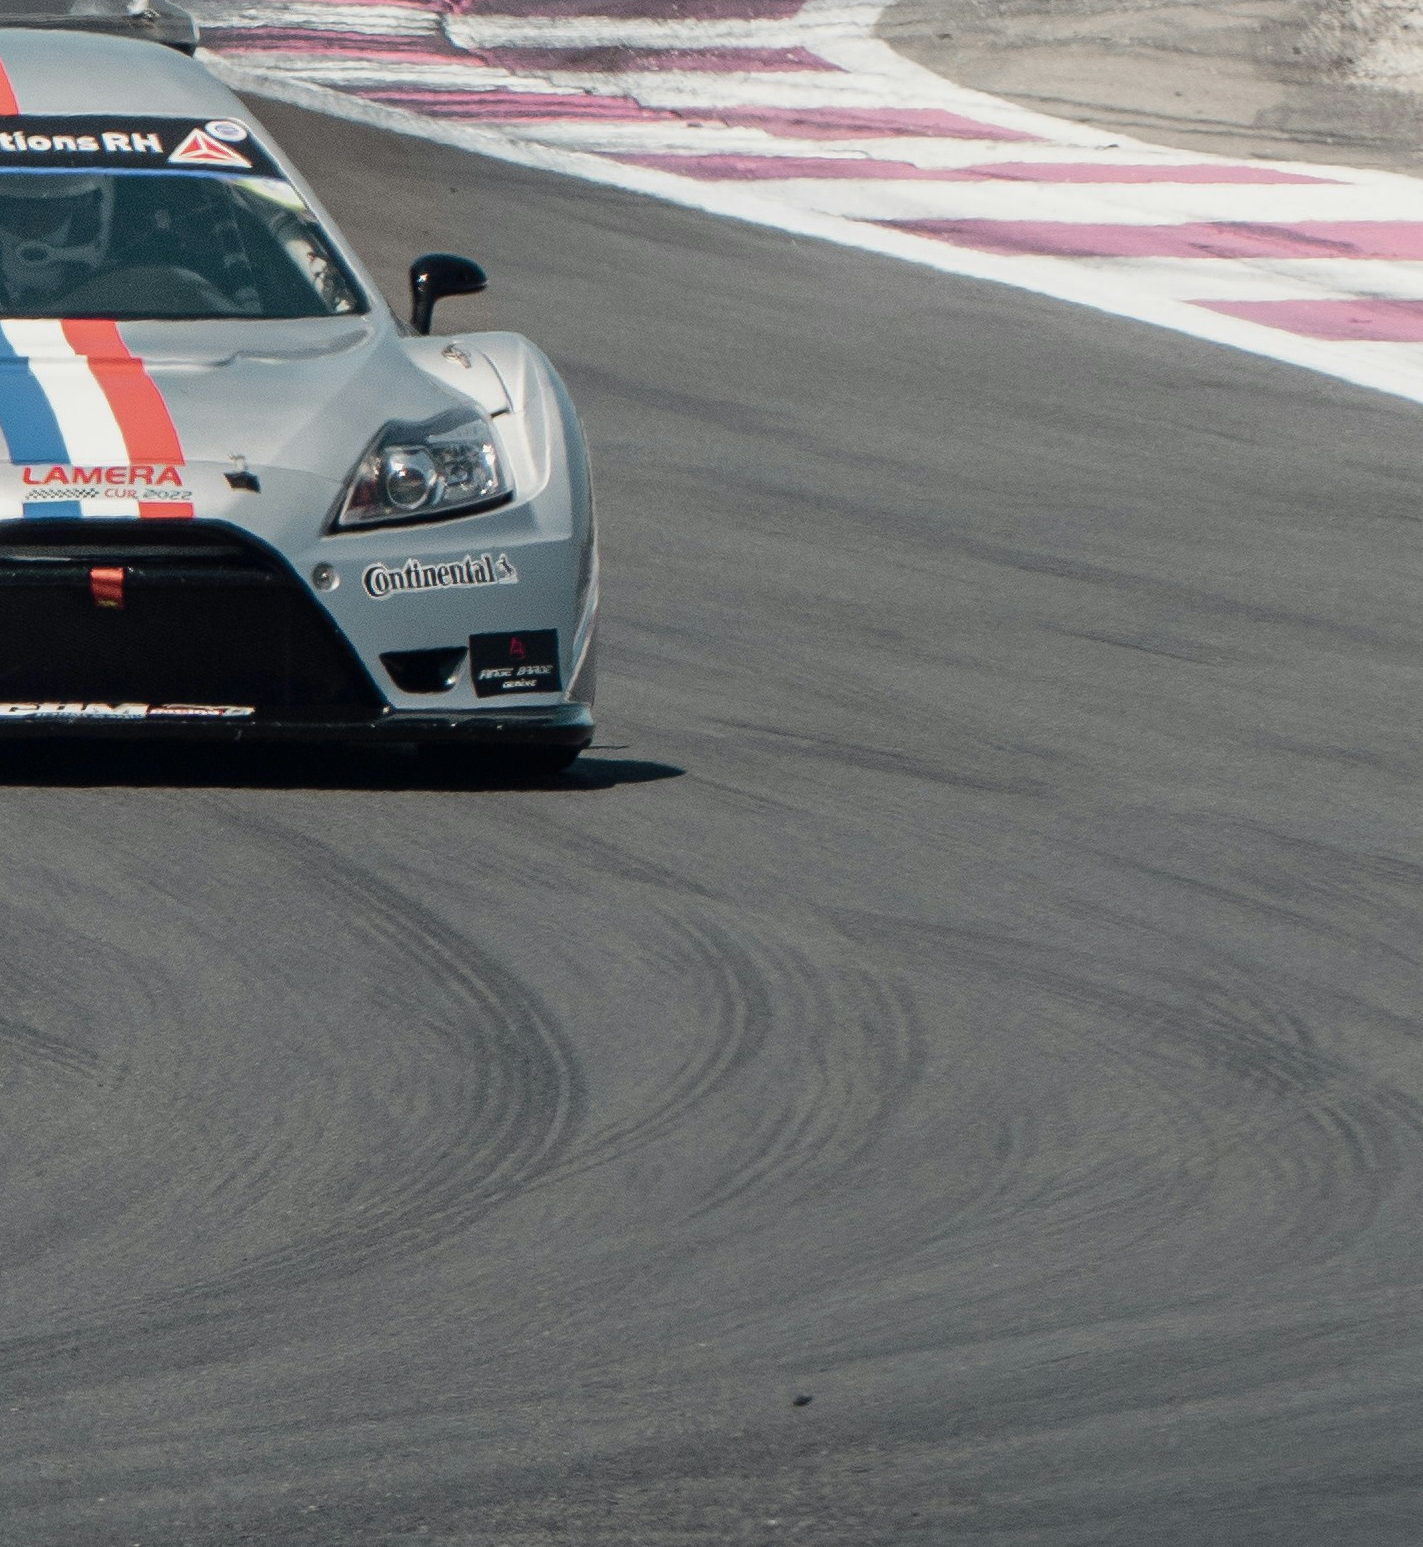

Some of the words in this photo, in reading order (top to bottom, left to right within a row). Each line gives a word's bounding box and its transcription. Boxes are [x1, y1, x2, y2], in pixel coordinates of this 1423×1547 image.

[101, 131, 164, 153] RH
[23, 465, 183, 487] LAMERA
[142, 488, 193, 501] 2022
[363, 555, 496, 598] Continental
